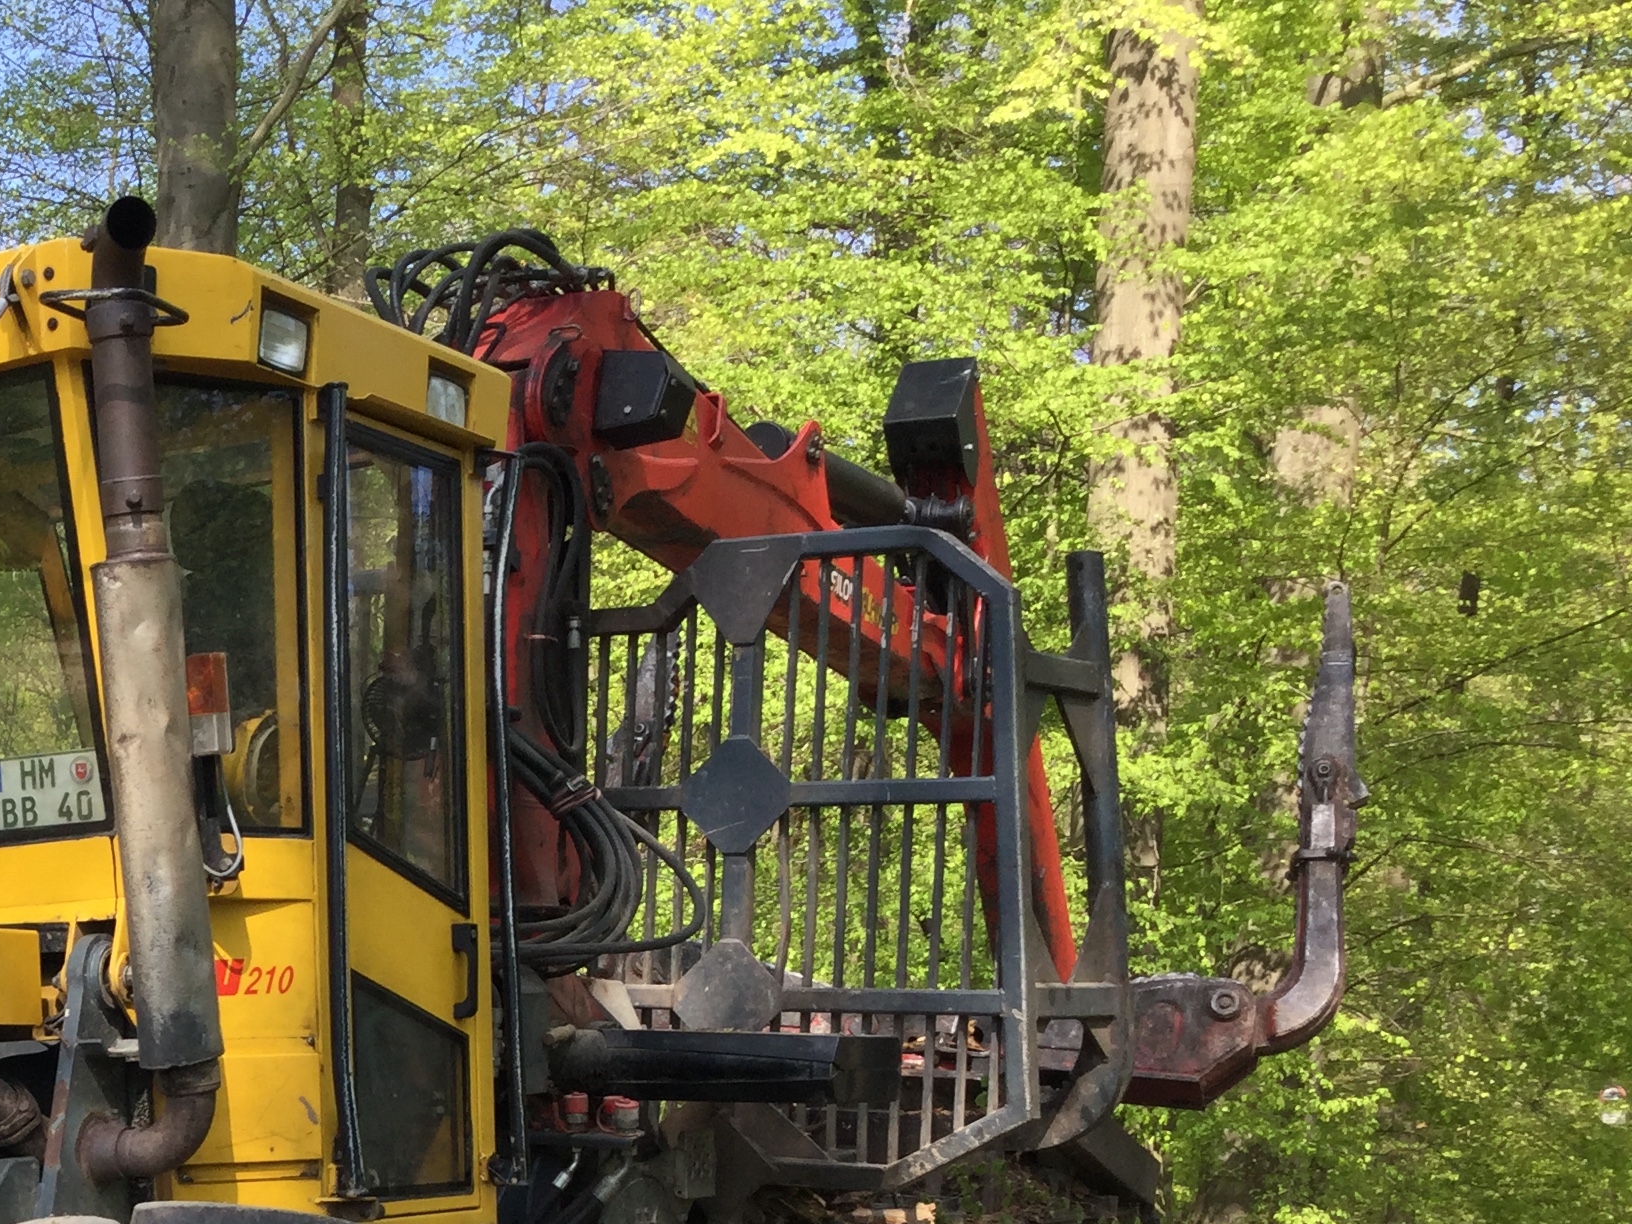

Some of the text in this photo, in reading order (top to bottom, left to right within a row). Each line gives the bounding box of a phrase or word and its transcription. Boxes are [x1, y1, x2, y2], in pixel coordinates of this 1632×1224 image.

[19, 757, 56, 790] HM
[2, 789, 93, 829] BB 40
[243, 965, 295, 995] 210
